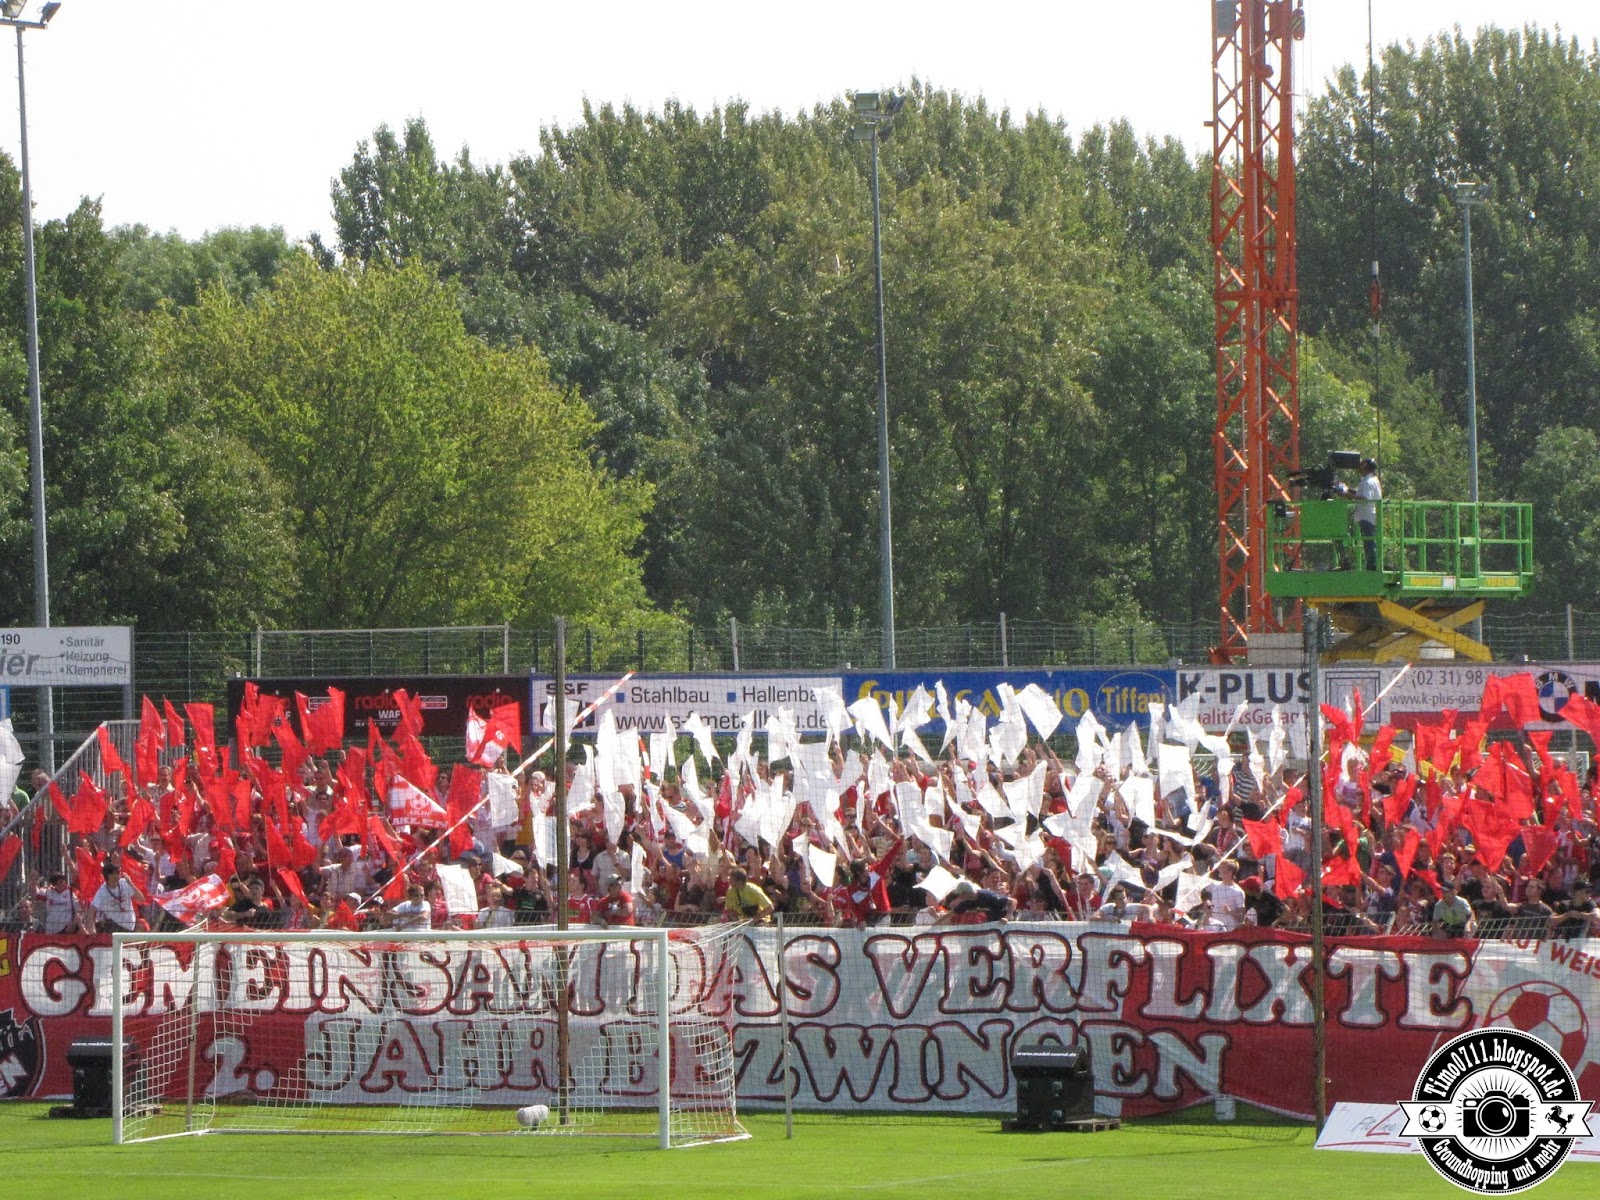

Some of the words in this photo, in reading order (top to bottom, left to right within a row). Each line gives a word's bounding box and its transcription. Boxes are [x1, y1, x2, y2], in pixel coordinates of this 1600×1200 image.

[66, 637, 105, 647] Sanitär
[66, 651, 110, 663] Heizung
[66, 665, 127, 677] Klempnerei
[631, 686, 709, 703] Stahlbau
[742, 686, 820, 702] Hallenba
[1179, 672, 1312, 704] K-PLUS
[627, 932, 842, 1019] DAS
[863, 929, 1475, 1033] VERFLIXTE
[202, 1035, 280, 1097] 2.
